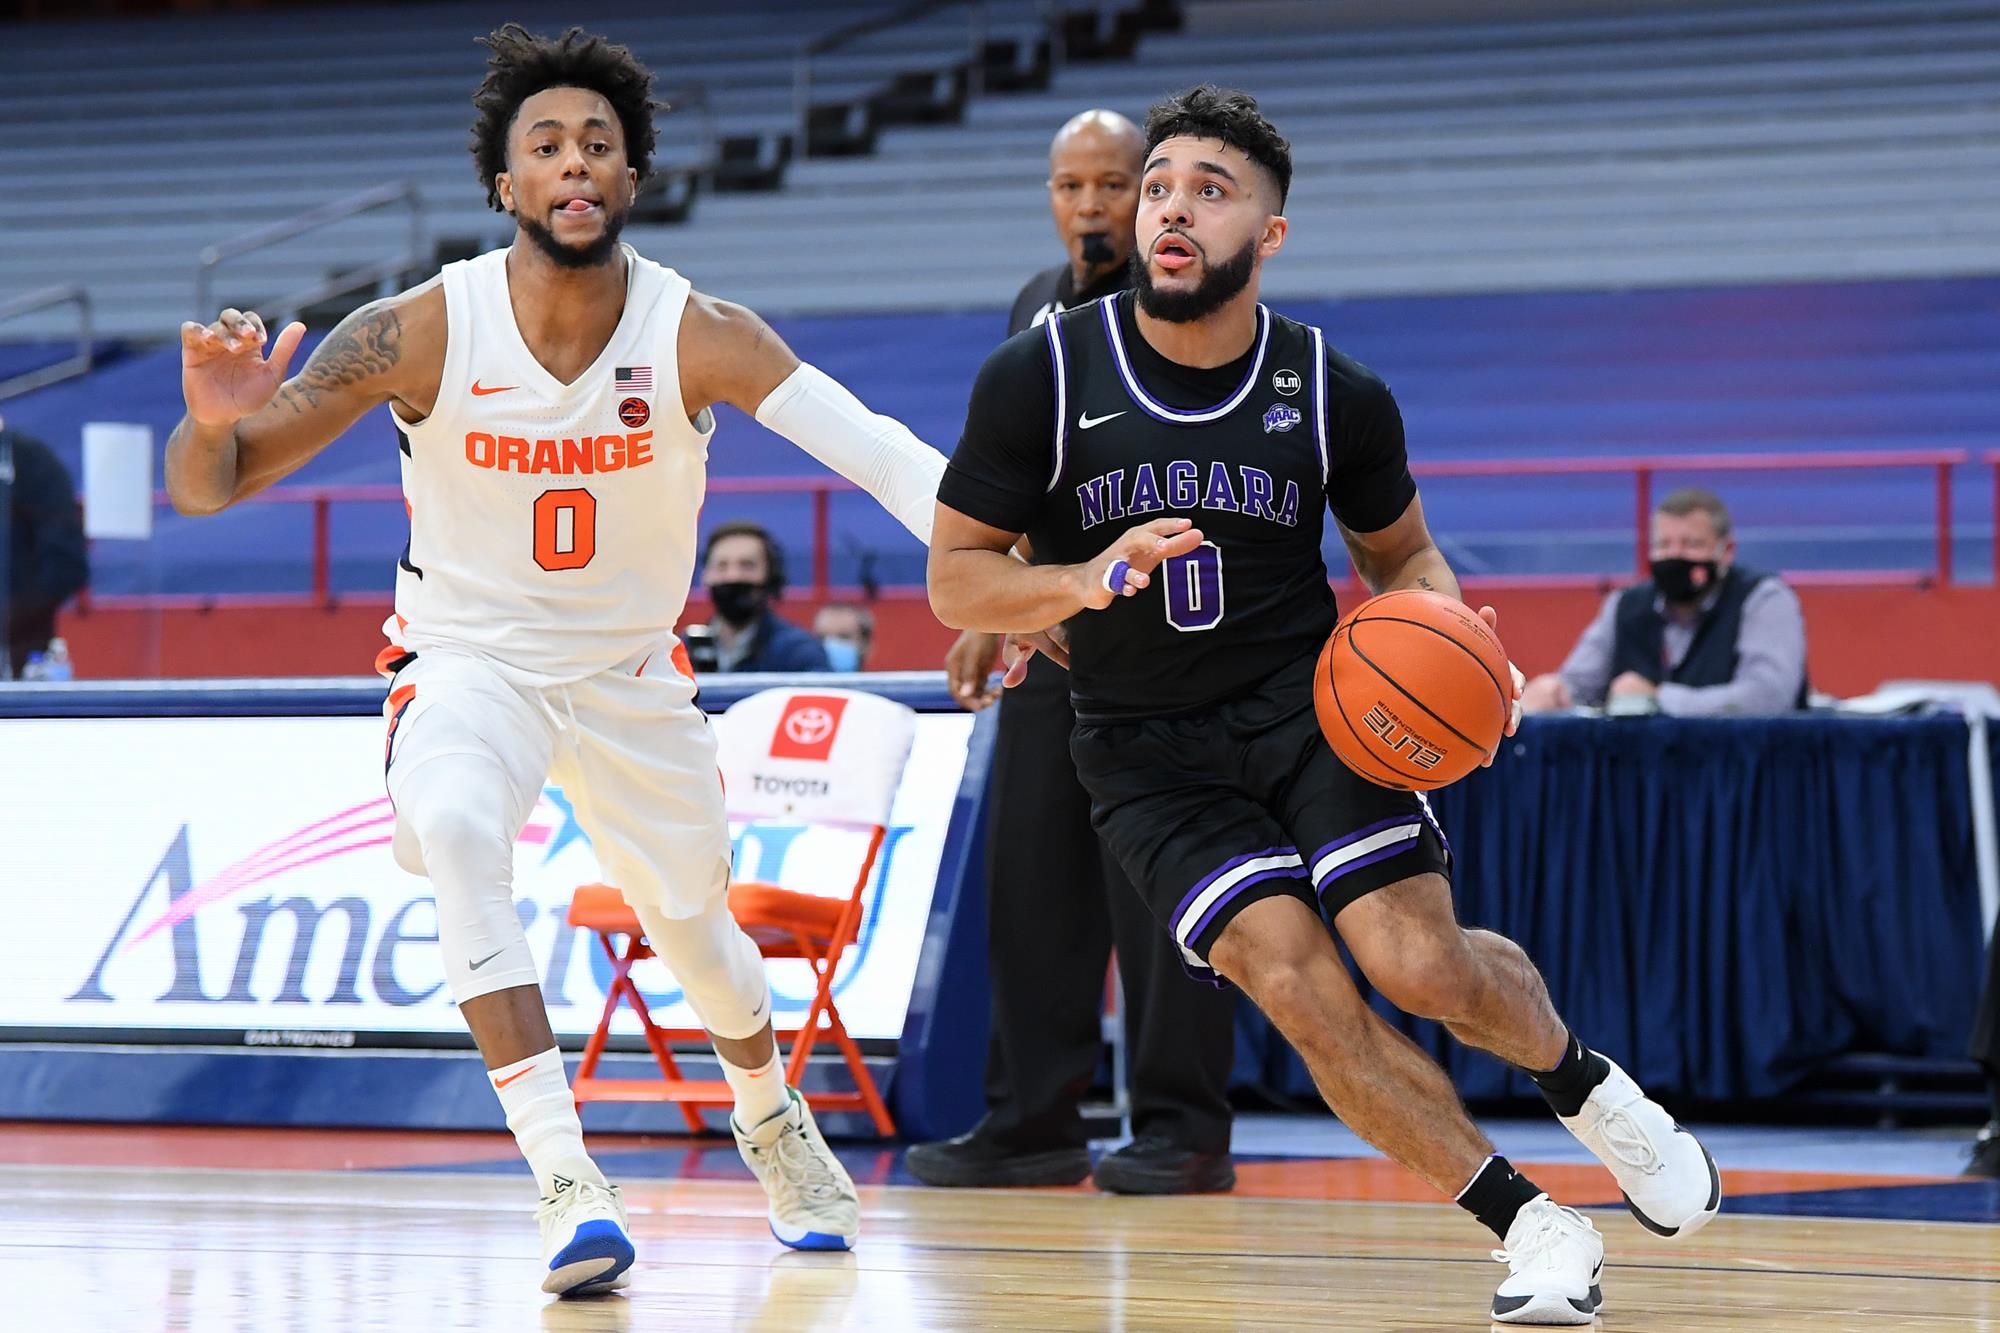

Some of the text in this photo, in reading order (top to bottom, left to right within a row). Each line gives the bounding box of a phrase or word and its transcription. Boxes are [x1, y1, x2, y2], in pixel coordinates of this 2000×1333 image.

[1275, 376, 1299, 389] BLM
[465, 430, 654, 475] ORANGE
[1076, 460, 1299, 531] NIAGARA
[533, 487, 597, 572] 0
[1162, 540, 1225, 633] 0
[1361, 705, 1444, 771] ELITE
[1377, 700, 1449, 756] CHAMPIONSHIP
